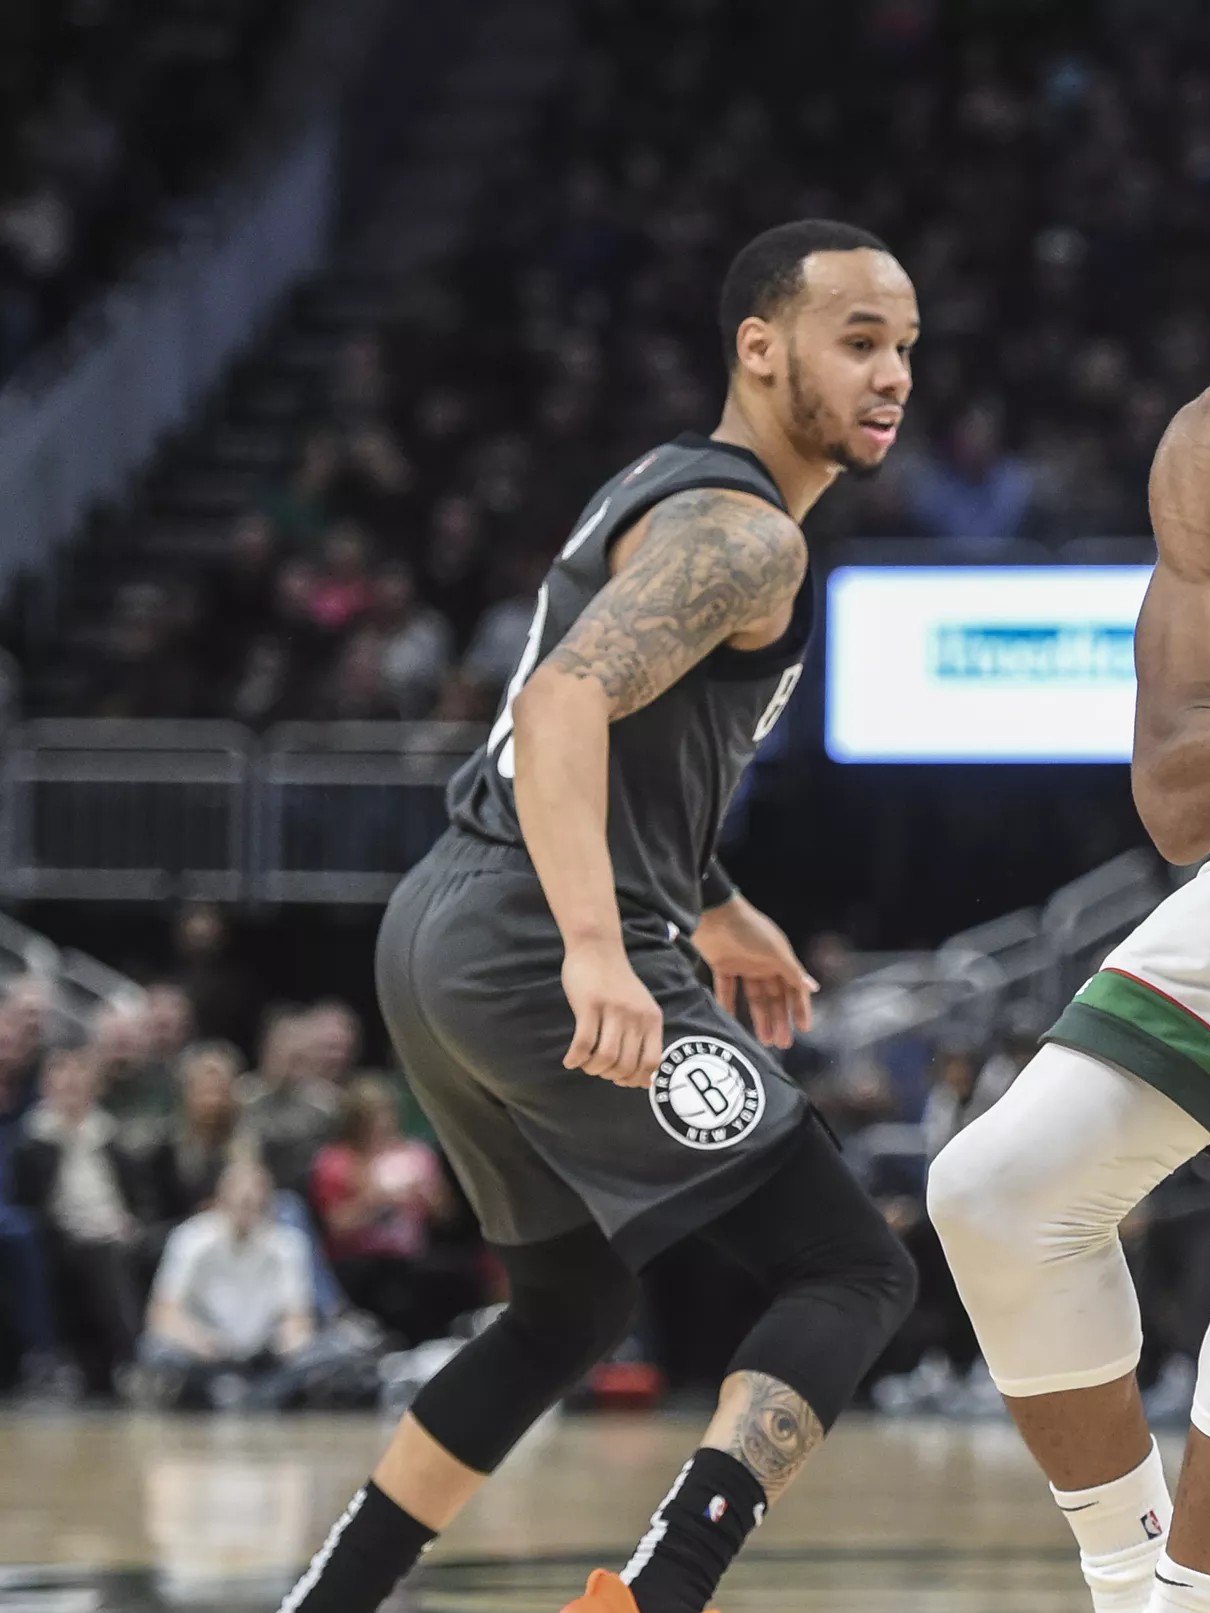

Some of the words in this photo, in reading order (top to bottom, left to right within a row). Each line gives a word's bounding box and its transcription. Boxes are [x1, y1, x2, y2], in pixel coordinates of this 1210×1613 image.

[655, 1042, 733, 1104] BROOKLYN
[687, 1067, 729, 1117] B
[685, 1126, 728, 1145] NEW
[732, 1088, 758, 1132] YORK
